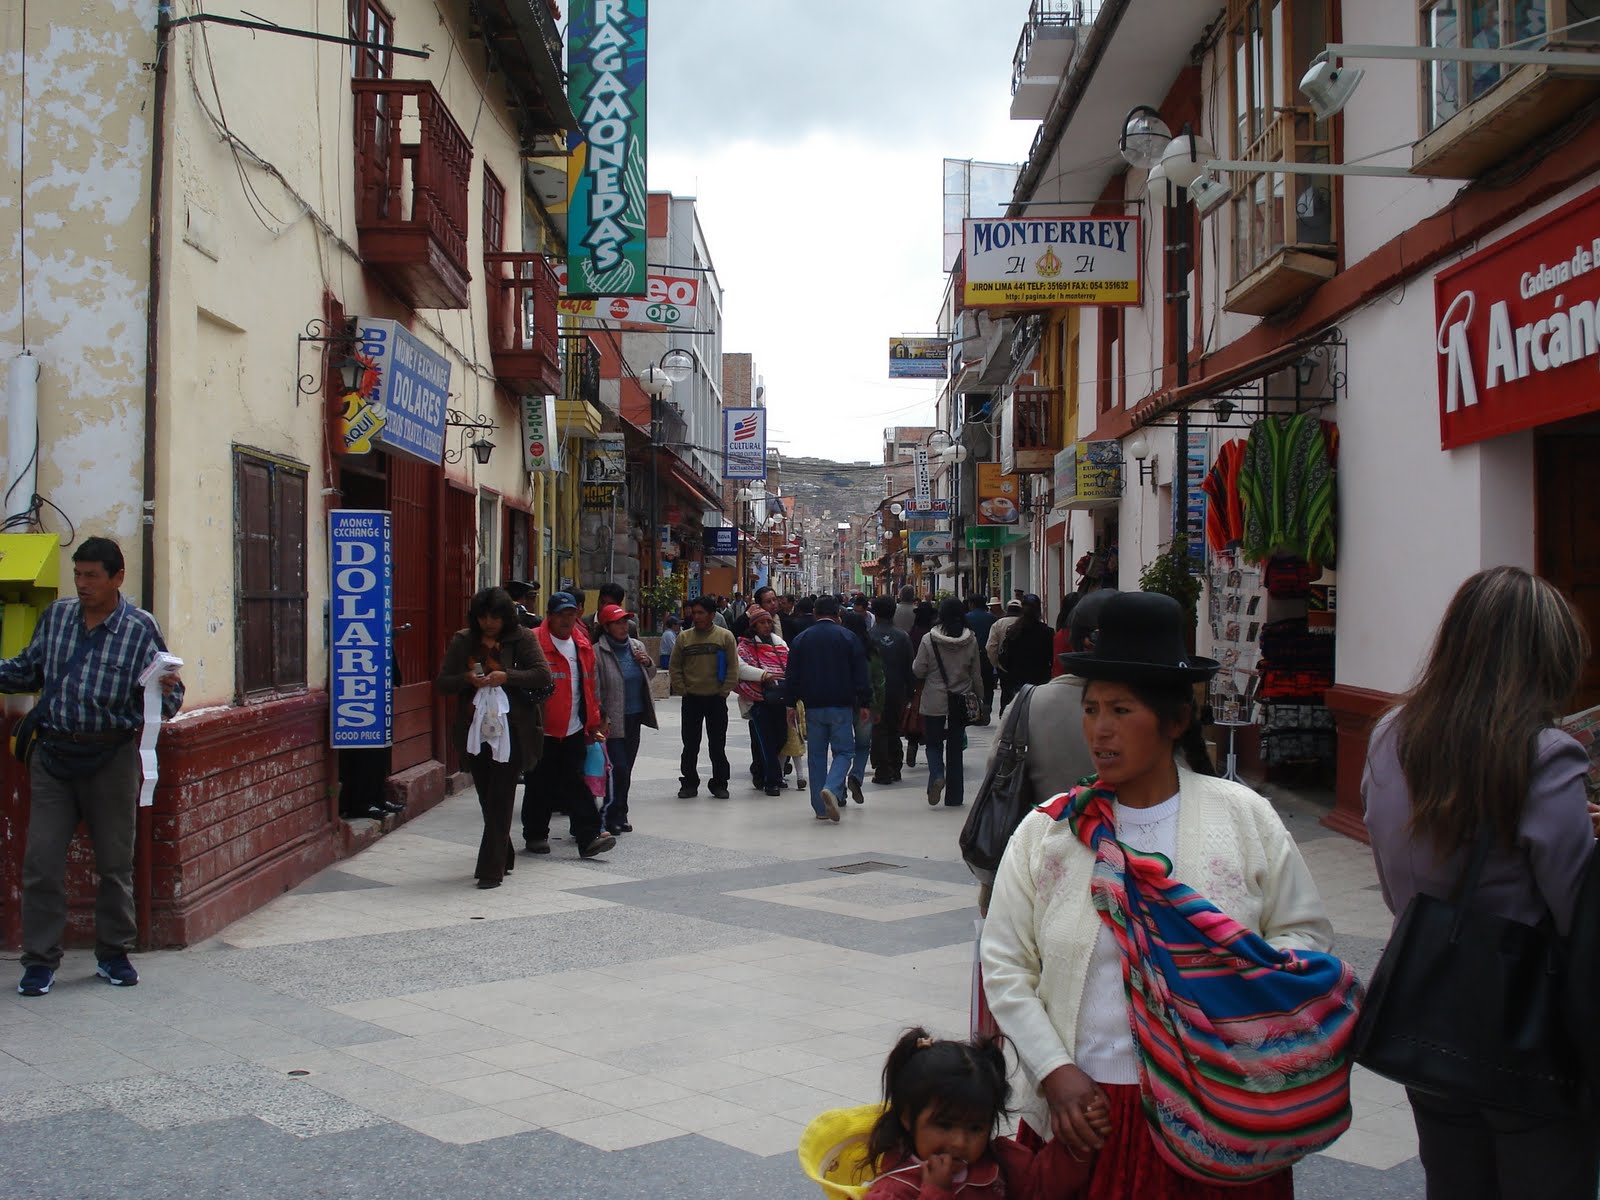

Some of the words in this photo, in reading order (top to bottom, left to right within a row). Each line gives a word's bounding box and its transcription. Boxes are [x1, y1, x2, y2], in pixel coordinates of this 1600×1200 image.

[973, 221, 1130, 256] MONTERREY
[972, 283, 993, 291] JIRON
[994, 282, 1012, 291] LIMA
[1013, 282, 1026, 290] 441
[1027, 282, 1046, 290] TELF:
[1047, 282, 1071, 290] 351691
[1072, 282, 1089, 290] FAX:
[1090, 281, 1103, 289] 054
[1104, 281, 1129, 290] 351632
[1520, 263, 1572, 300] Cadena
[1571, 245, 1593, 278] de
[648, 304, 679, 322] ojo
[1486, 294, 1600, 389] Arcán
[395, 336, 417, 371] MONEY
[419, 353, 448, 391] EXCHANGE
[393, 371, 441, 428] DOLARES
[730, 442, 761, 450] CULTURAL
[333, 527, 380, 537] EXCHANGE
[339, 518, 373, 527] MONEY
[383, 516, 391, 578] EUROS
[334, 541, 379, 728] DOLARES
[334, 731, 359, 741] GOOD
[360, 731, 381, 741] PRICE
